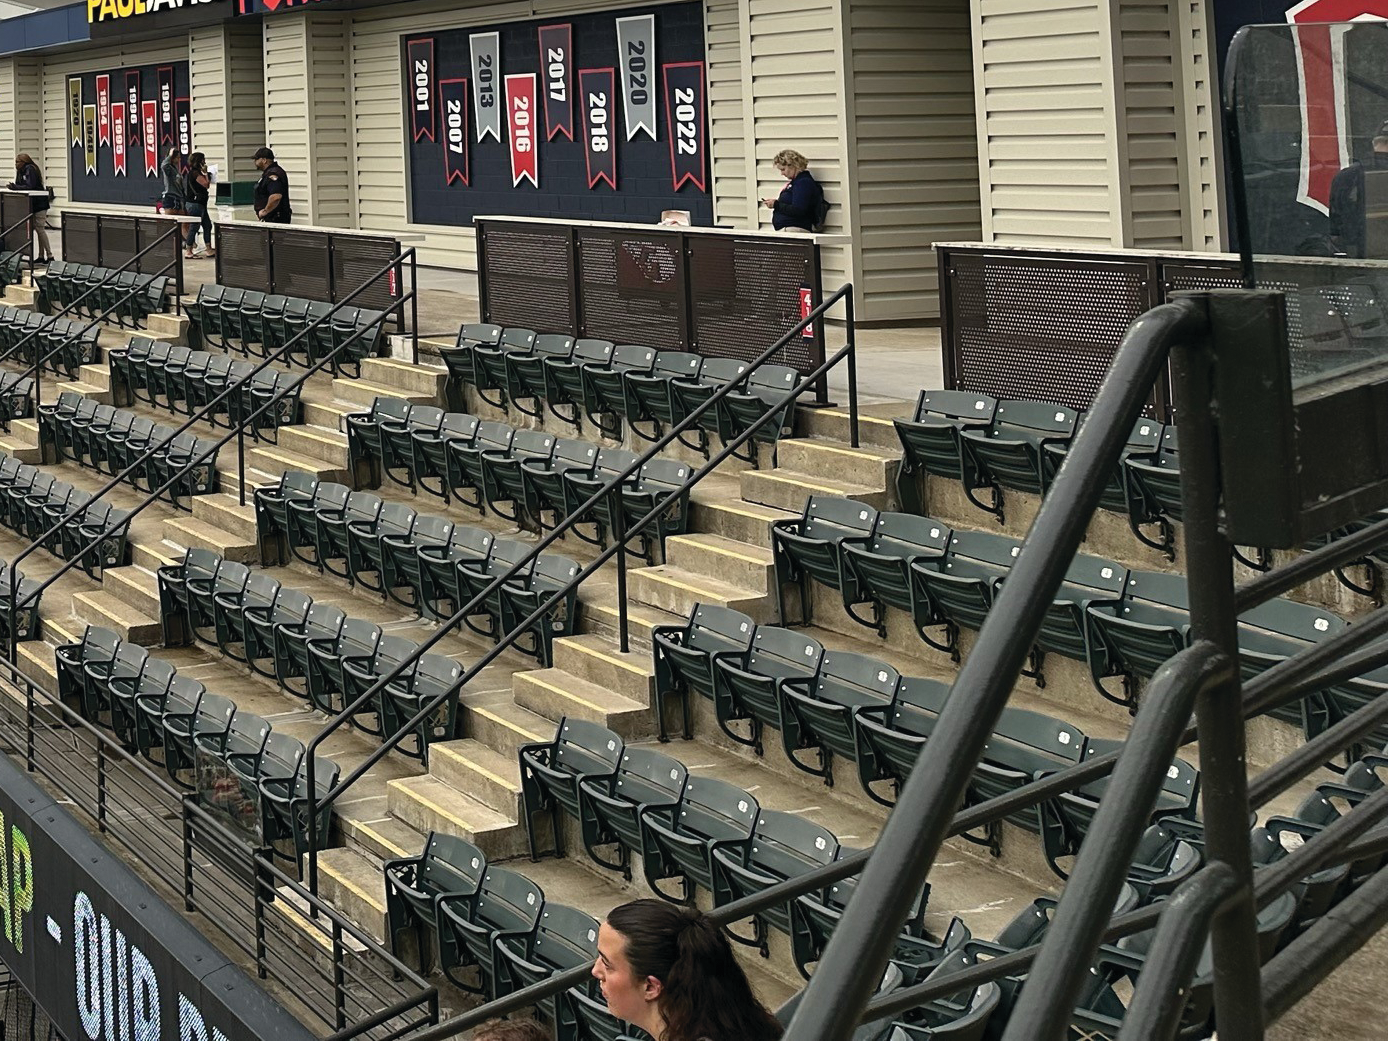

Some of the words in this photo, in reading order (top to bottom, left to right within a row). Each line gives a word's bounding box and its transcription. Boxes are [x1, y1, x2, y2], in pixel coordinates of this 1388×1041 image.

[414, 59, 430, 112] 2001
[478, 54, 495, 109] 2013
[547, 47, 567, 102] 2017
[627, 40, 649, 106] 2020
[99, 88, 108, 126] 1954
[145, 115, 155, 153] 1997
[179, 113, 189, 155] 1999
[446, 99, 464, 155] 2007
[513, 95, 531, 154] 2016
[589, 92, 609, 153] 2018
[674, 87, 697, 155] 2022
